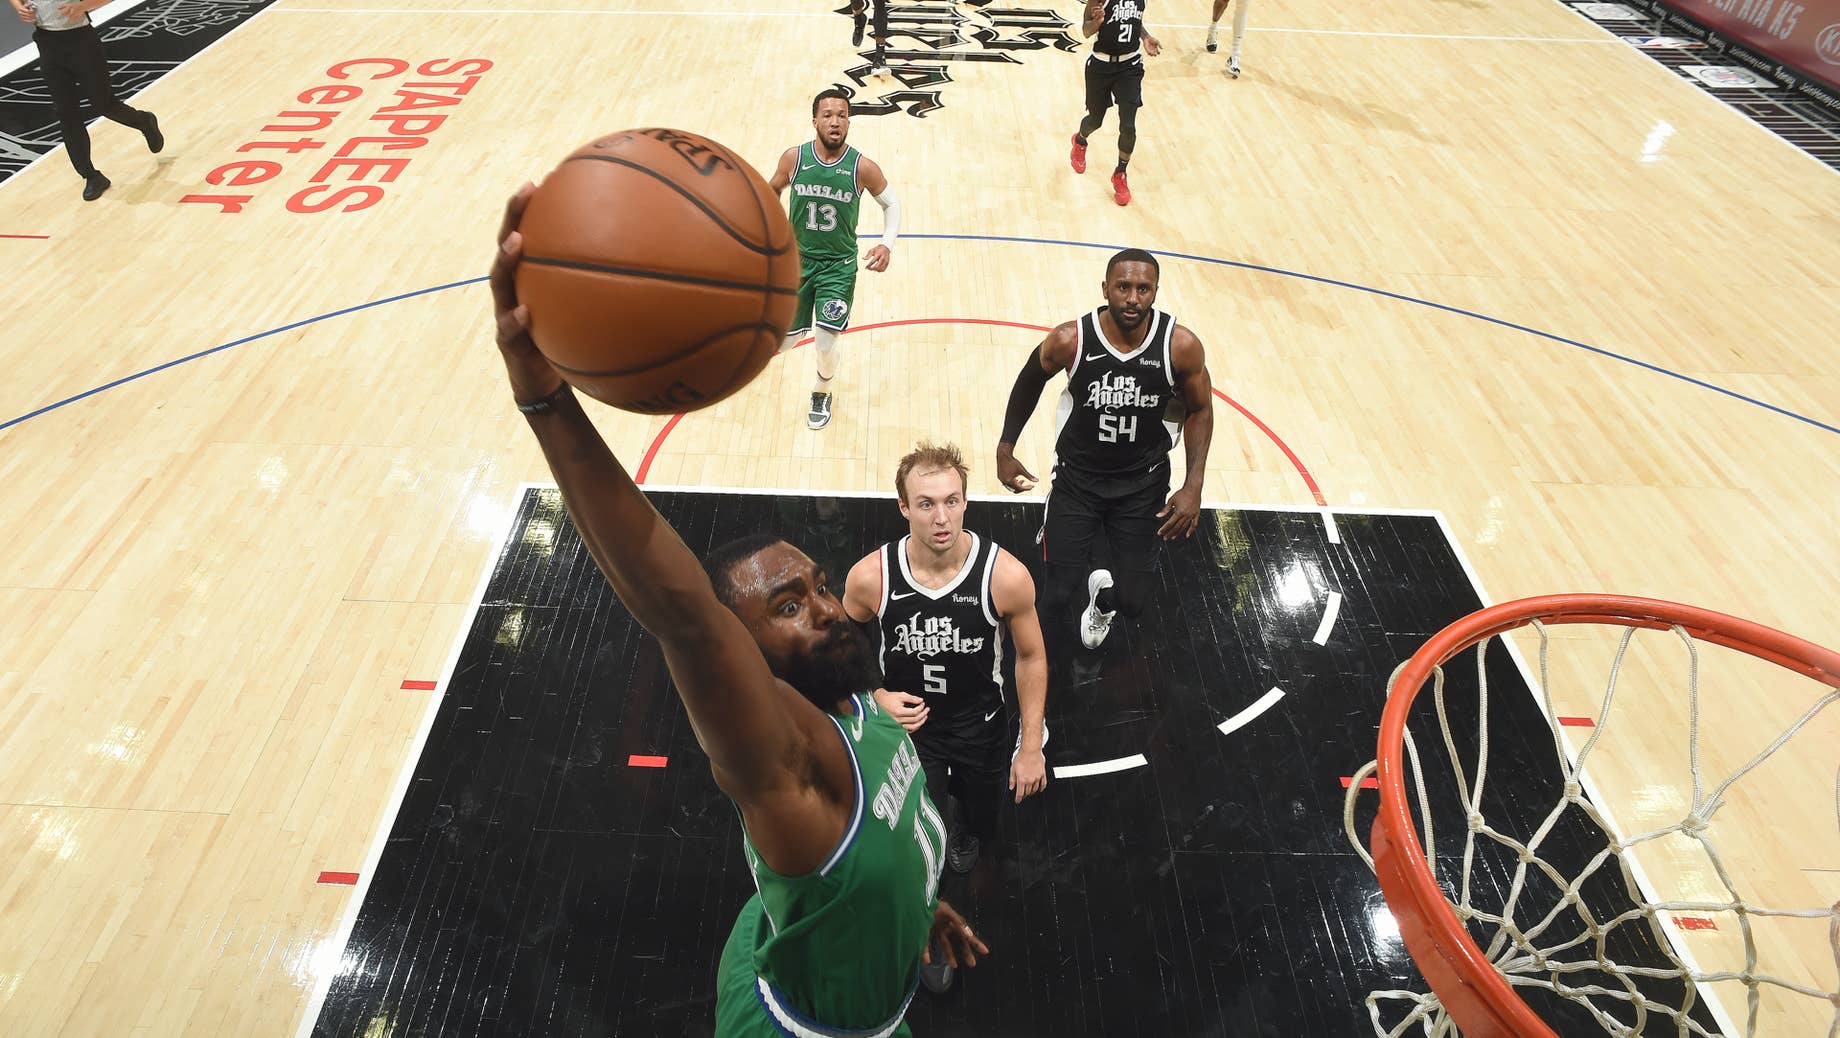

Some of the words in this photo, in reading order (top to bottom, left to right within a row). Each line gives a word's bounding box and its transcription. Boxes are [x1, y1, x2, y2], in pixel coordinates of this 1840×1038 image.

[1106, 4, 1143, 24] Angele
[1767, 1, 1805, 40] K5
[1118, 23, 1133, 43] 21
[178, 57, 410, 214] Center
[285, 57, 494, 214] STAPLES
[794, 183, 853, 203] DALLAS
[805, 201, 838, 232] 13
[1139, 357, 1161, 369] honey
[1102, 370, 1136, 392] Los
[1083, 380, 1160, 414] Angeles
[1098, 414, 1138, 443] 54
[951, 593, 979, 605] honey
[909, 611, 953, 636] Los
[891, 623, 985, 661] Angeles
[923, 664, 947, 694] 5
[873, 733, 921, 831] DALL
[914, 786, 948, 907] 11
